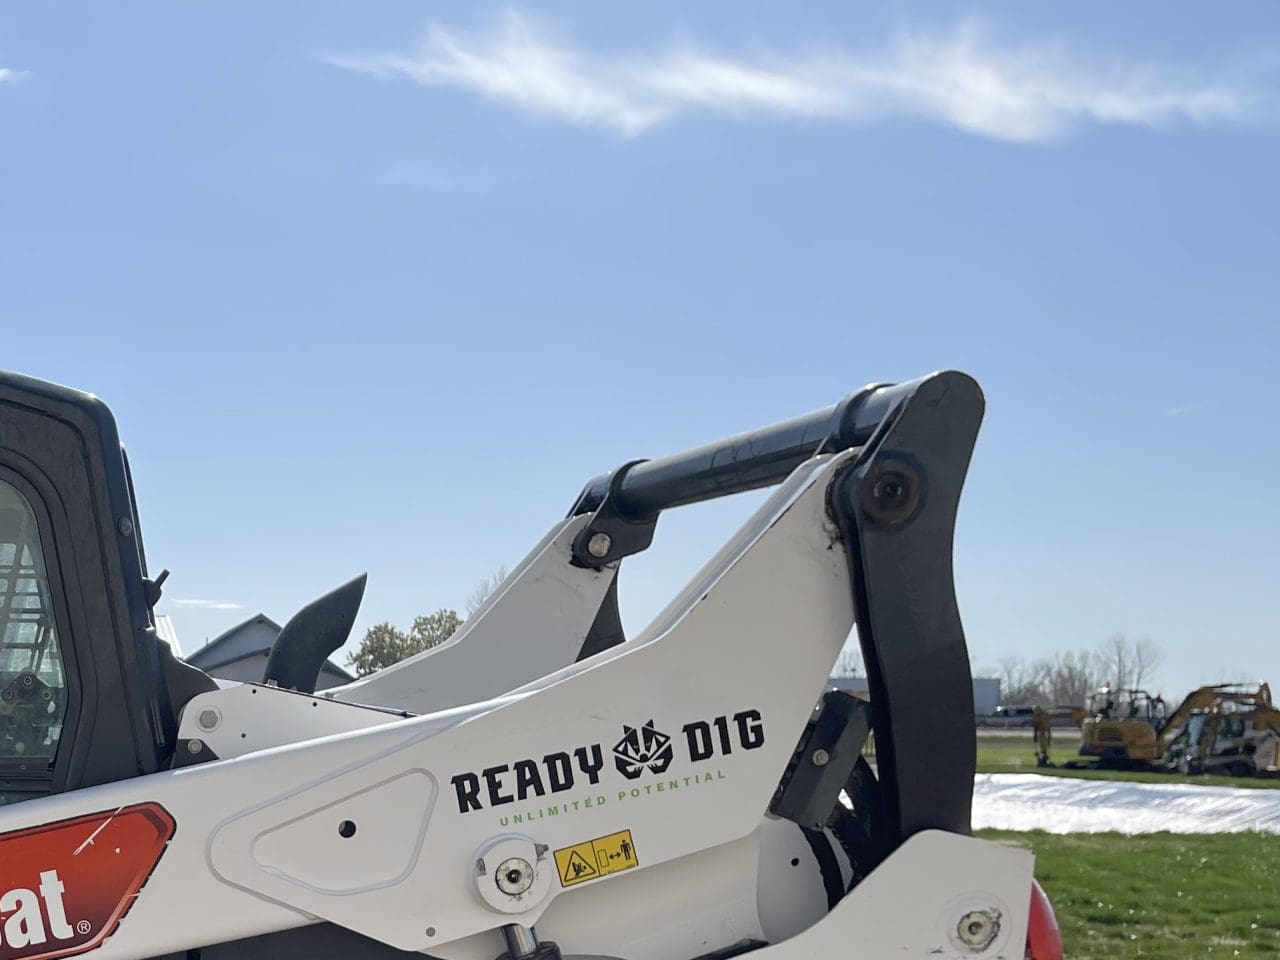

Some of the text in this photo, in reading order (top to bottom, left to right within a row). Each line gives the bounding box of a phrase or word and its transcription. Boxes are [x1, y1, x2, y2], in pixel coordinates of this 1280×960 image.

[451, 709, 765, 814] READY DIG
[499, 770, 727, 827] UNLIMITED POTENTIAL
